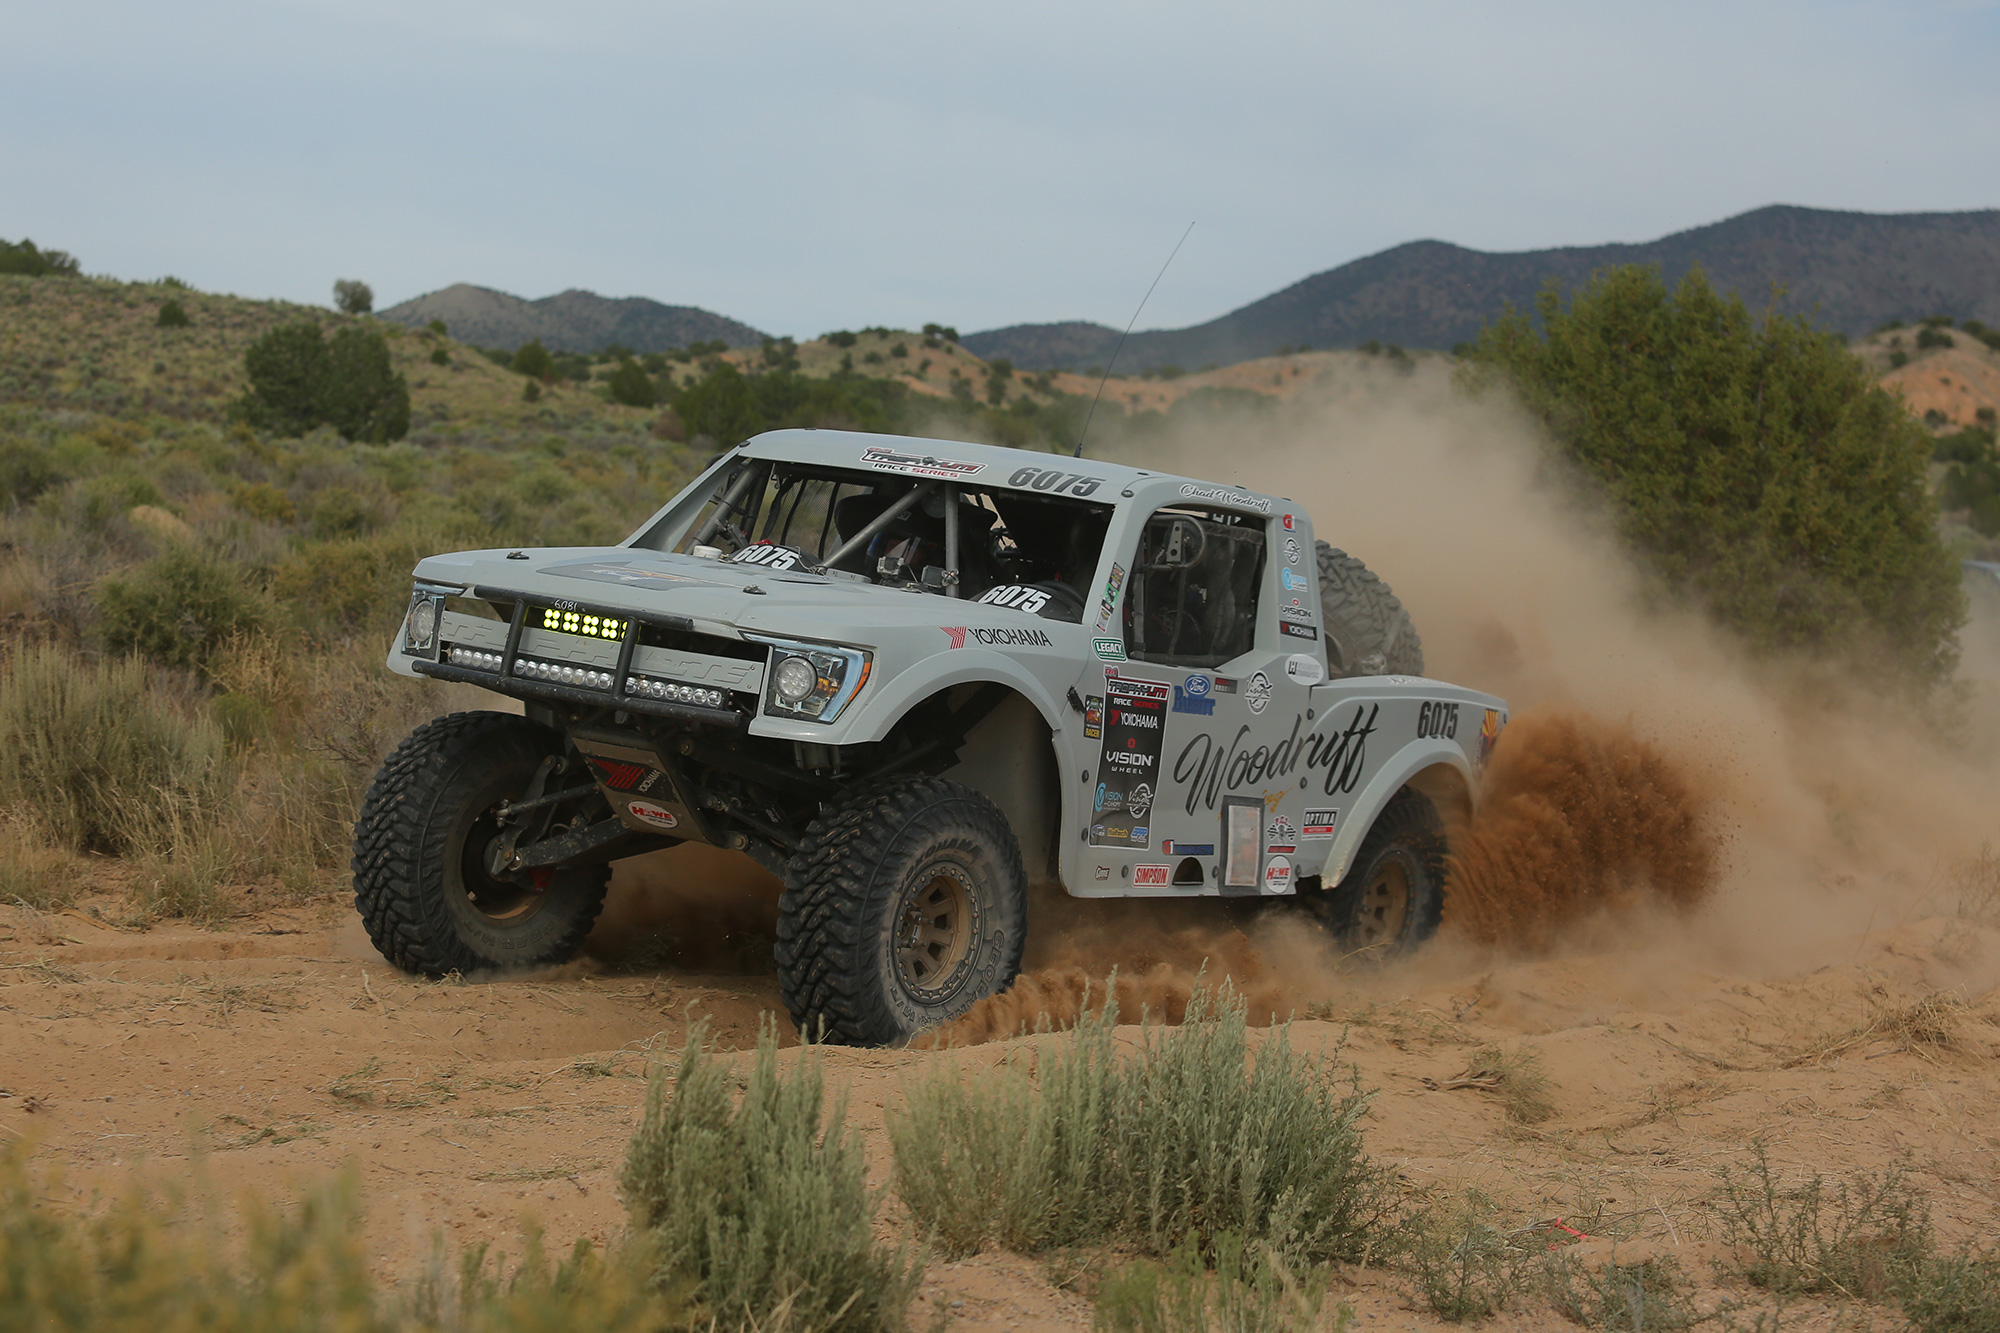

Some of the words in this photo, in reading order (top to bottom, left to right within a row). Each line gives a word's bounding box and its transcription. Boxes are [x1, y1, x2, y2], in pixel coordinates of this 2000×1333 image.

[874, 463, 907, 471] RACE
[911, 467, 958, 477] SERIES
[1008, 467, 1107, 496] 6075
[1180, 484, 1215, 499] Chad
[1216, 490, 1271, 514] Woodruff
[733, 544, 800, 570] 6075
[978, 584, 1053, 614] 6075
[1280, 605, 1312, 618] VISION
[968, 627, 1054, 647] YOKOHAMA
[1095, 642, 1123, 654] LEGACY
[1189, 677, 1206, 692] Ford
[1113, 697, 1132, 706] RACE
[1133, 700, 1160, 709] SERIES
[1120, 711, 1159, 729] YOKOHAMA
[1417, 701, 1460, 739] 6075
[1105, 750, 1152, 767] VISION
[1173, 701, 1379, 817] Woodruff
[1111, 766, 1143, 775] WHEEL
[1304, 812, 1336, 826] OPTIMA
[1134, 867, 1169, 884] SIMPSON
